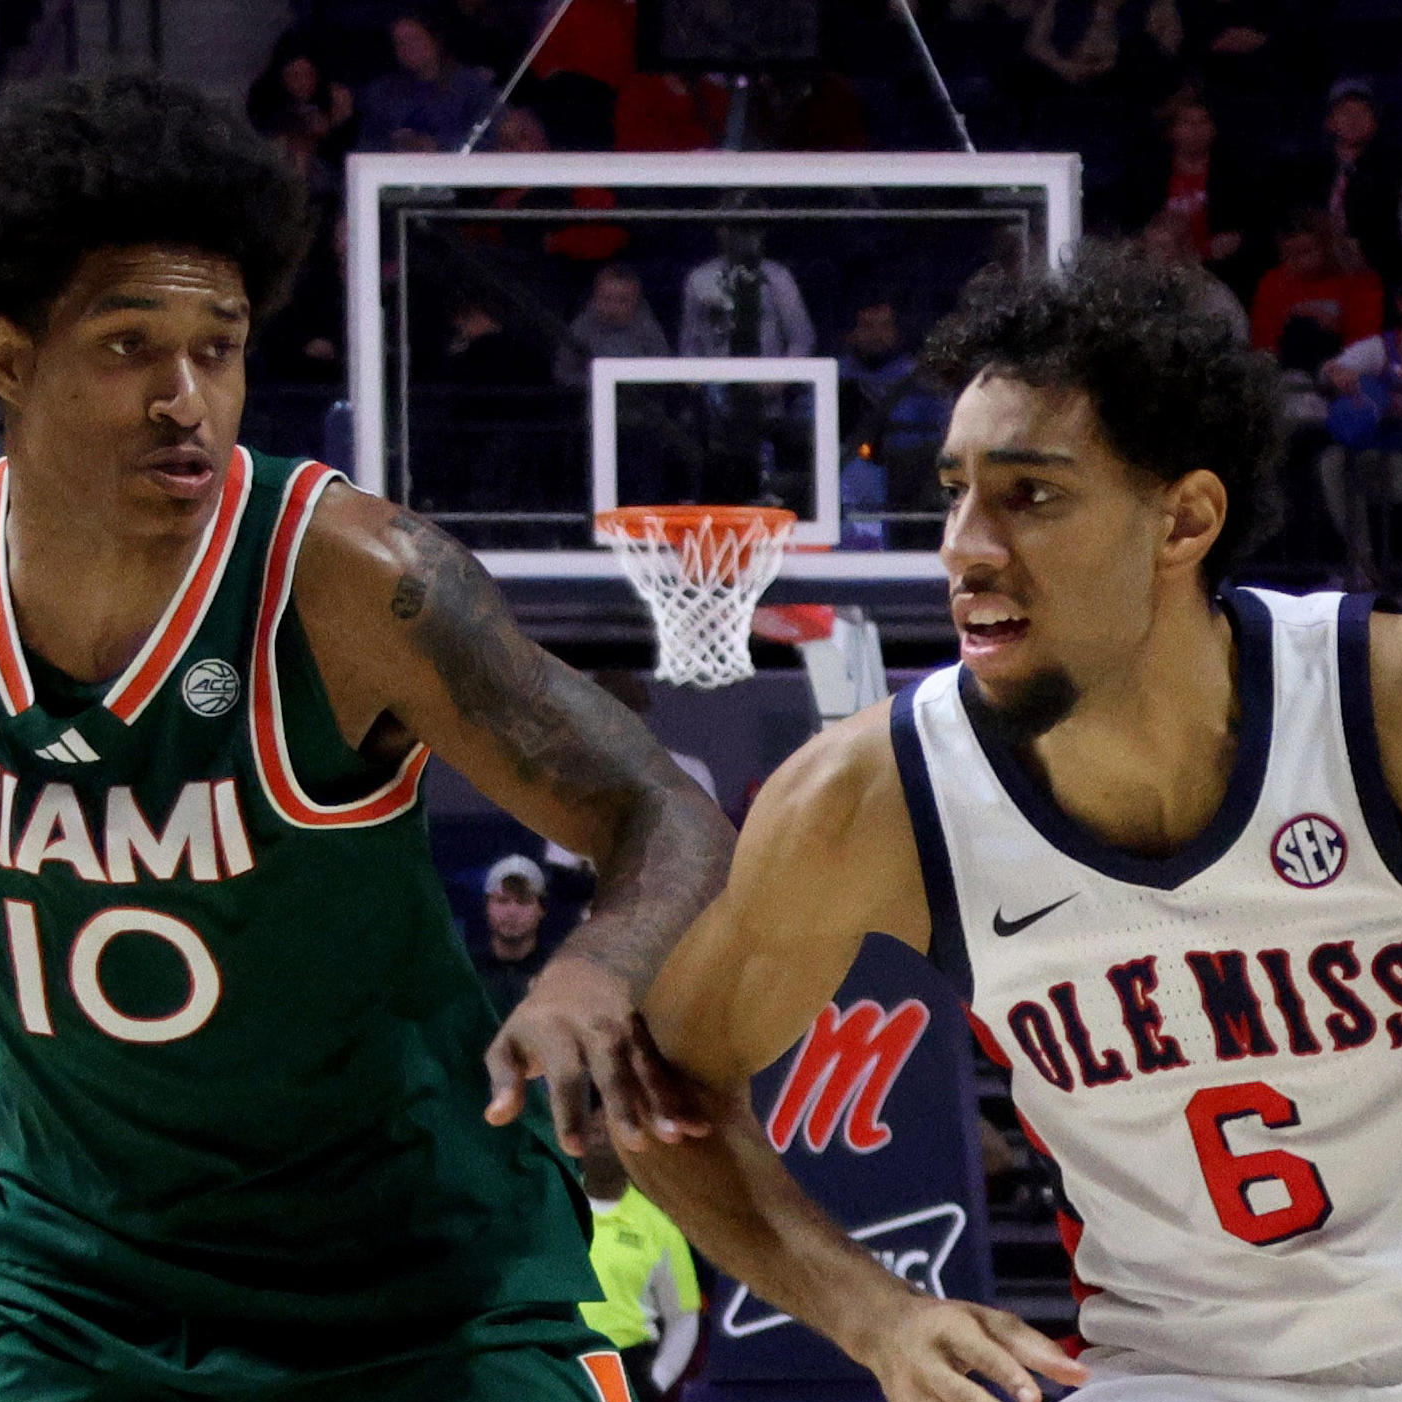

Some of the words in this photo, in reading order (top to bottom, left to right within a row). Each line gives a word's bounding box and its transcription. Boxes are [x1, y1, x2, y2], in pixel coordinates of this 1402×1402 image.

[1275, 817, 1343, 884] SEC
[2, 897, 223, 1043] 10
[1006, 954, 1188, 1094] OLE
[1184, 1080, 1334, 1247] 6
